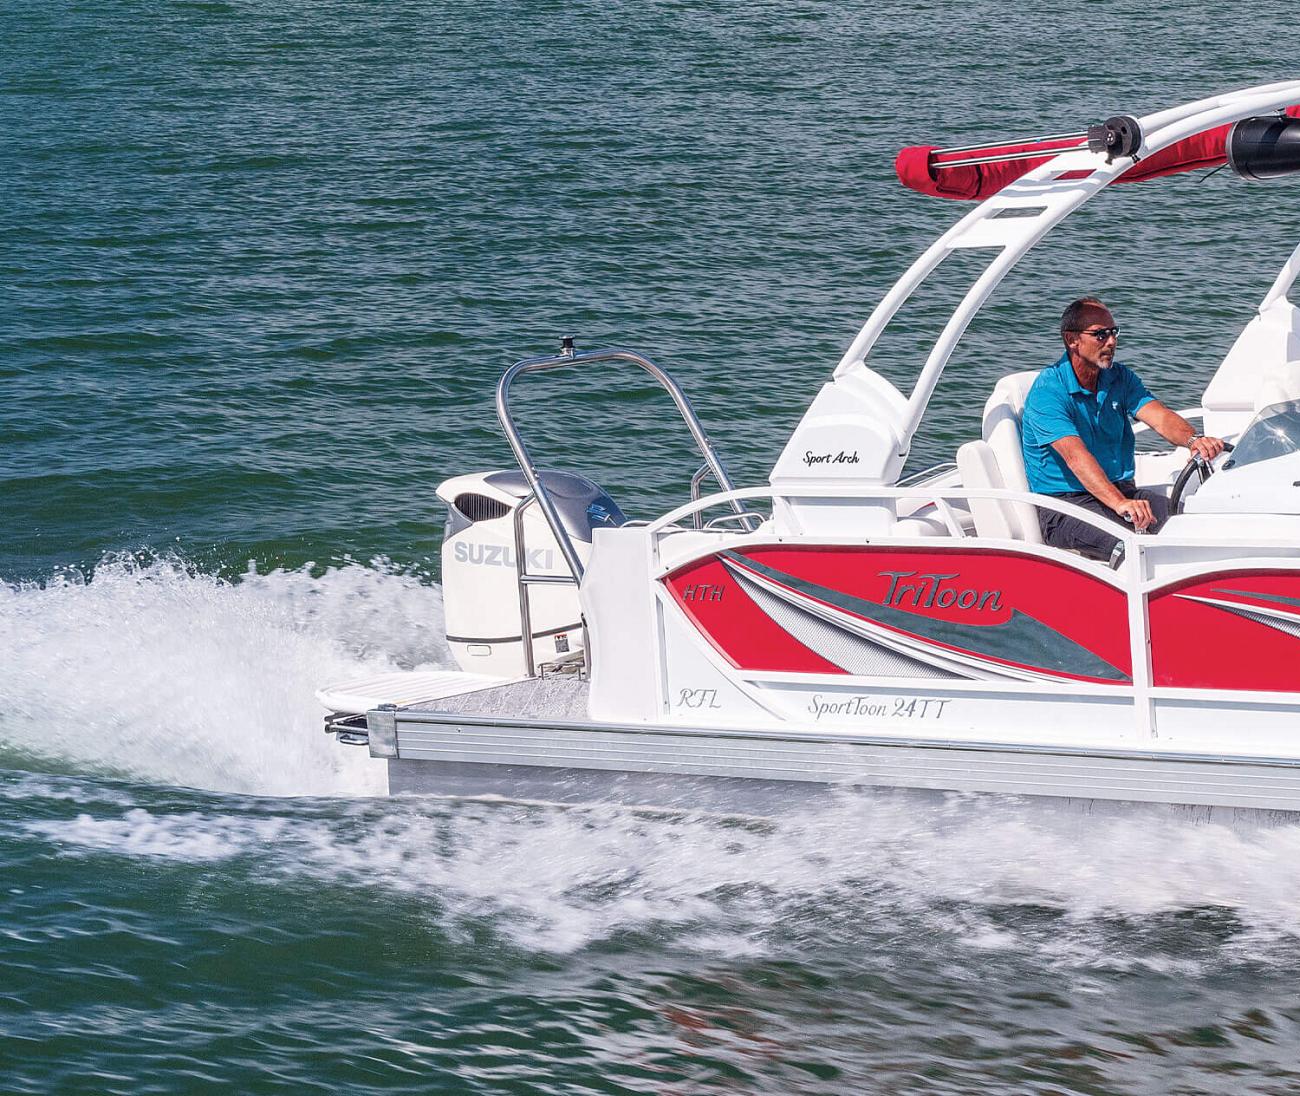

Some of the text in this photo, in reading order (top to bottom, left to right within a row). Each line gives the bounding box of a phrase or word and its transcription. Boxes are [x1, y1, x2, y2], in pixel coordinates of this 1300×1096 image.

[803, 450, 860, 467] Sport Arch
[454, 541, 554, 570] SUZUKI
[683, 584, 725, 601] HTH
[876, 571, 1003, 611] TriToon
[808, 694, 887, 720] SportToon
